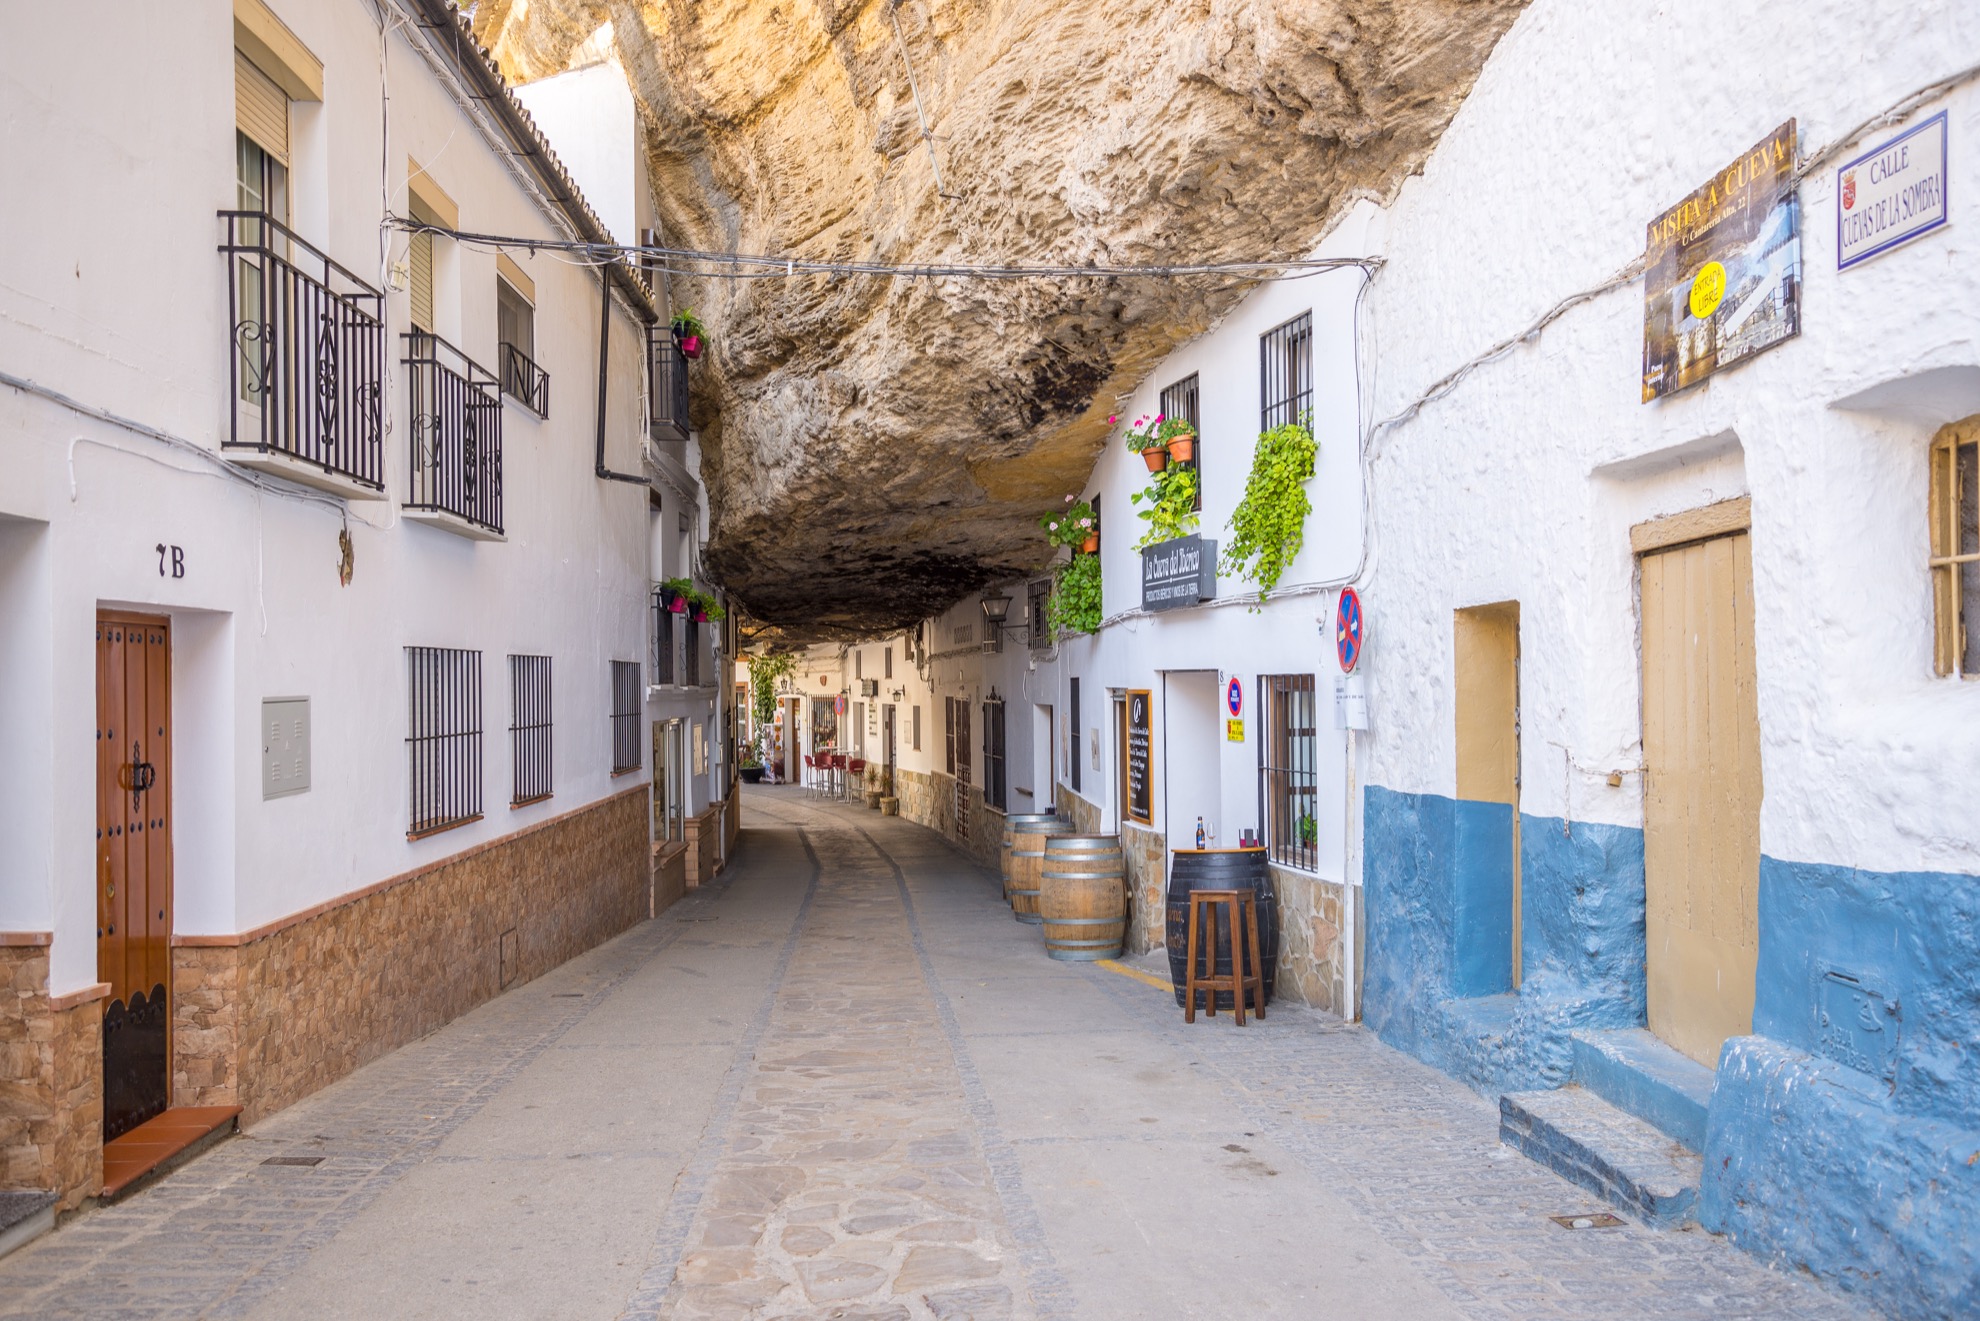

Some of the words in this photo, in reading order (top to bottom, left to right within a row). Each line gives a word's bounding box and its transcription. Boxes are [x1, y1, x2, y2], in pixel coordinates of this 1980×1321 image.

[1871, 145, 1909, 185] CALLE
[1652, 198, 1701, 246] VISITA
[1706, 185, 1719, 210] A
[1725, 137, 1784, 196] CUEVA
[1737, 196, 1746, 210] 22
[1843, 206, 1874, 248] CUEVAS
[1875, 199, 1887, 234] DE
[1889, 192, 1901, 227] LA
[1902, 172, 1941, 221] SOMBRA
[1694, 268, 1722, 296] ENTRADA
[1699, 287, 1719, 313] LIBRE
[1145, 556, 1153, 581] La
[1169, 549, 1179, 576] del
[1219, 670, 1224, 683] 8
